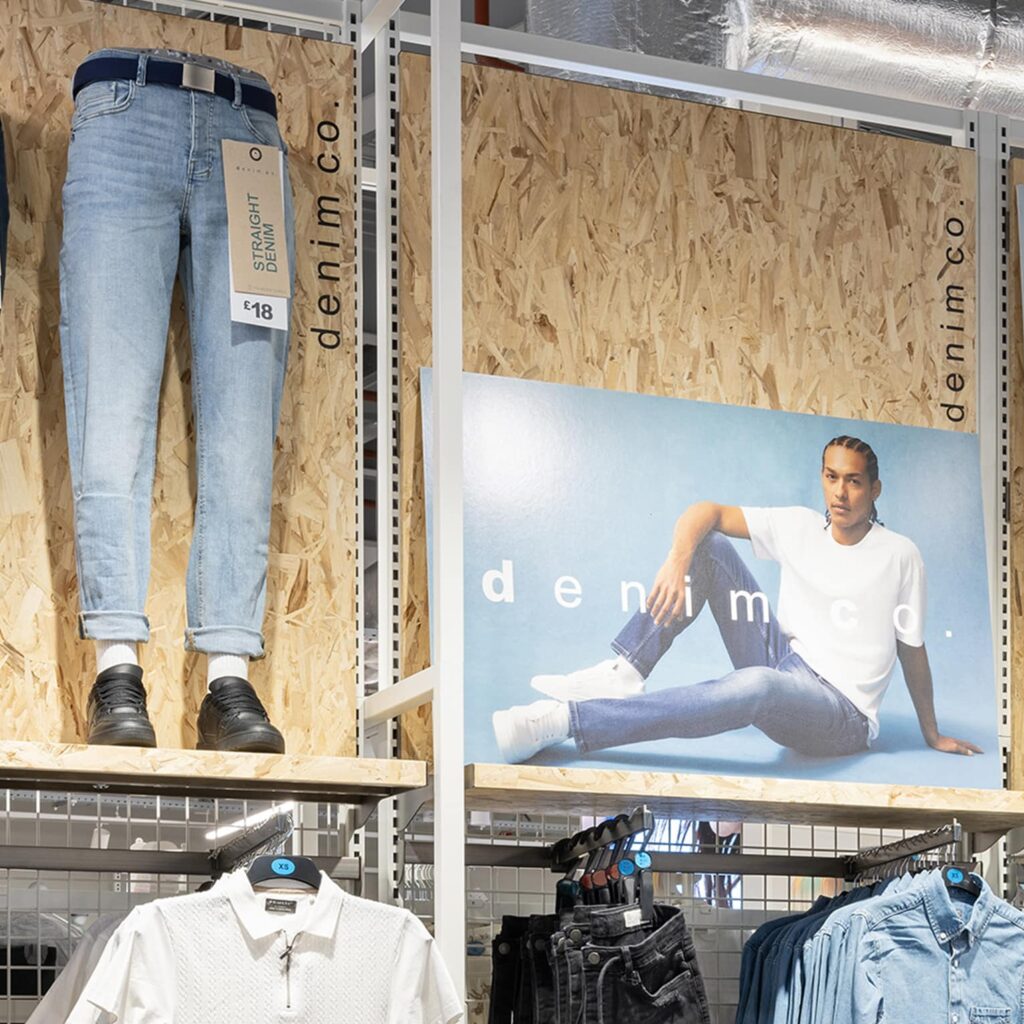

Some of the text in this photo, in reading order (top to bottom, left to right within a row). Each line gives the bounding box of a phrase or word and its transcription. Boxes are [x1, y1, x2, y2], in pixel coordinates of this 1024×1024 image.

[247, 193, 265, 272] STRAIGHT
[262, 223, 278, 273] DENIM
[310, 102, 341, 349] denim co.
[243, 300, 274, 320] £18
[940, 201, 965, 423] denim co.
[481, 559, 953, 638] denim co.
